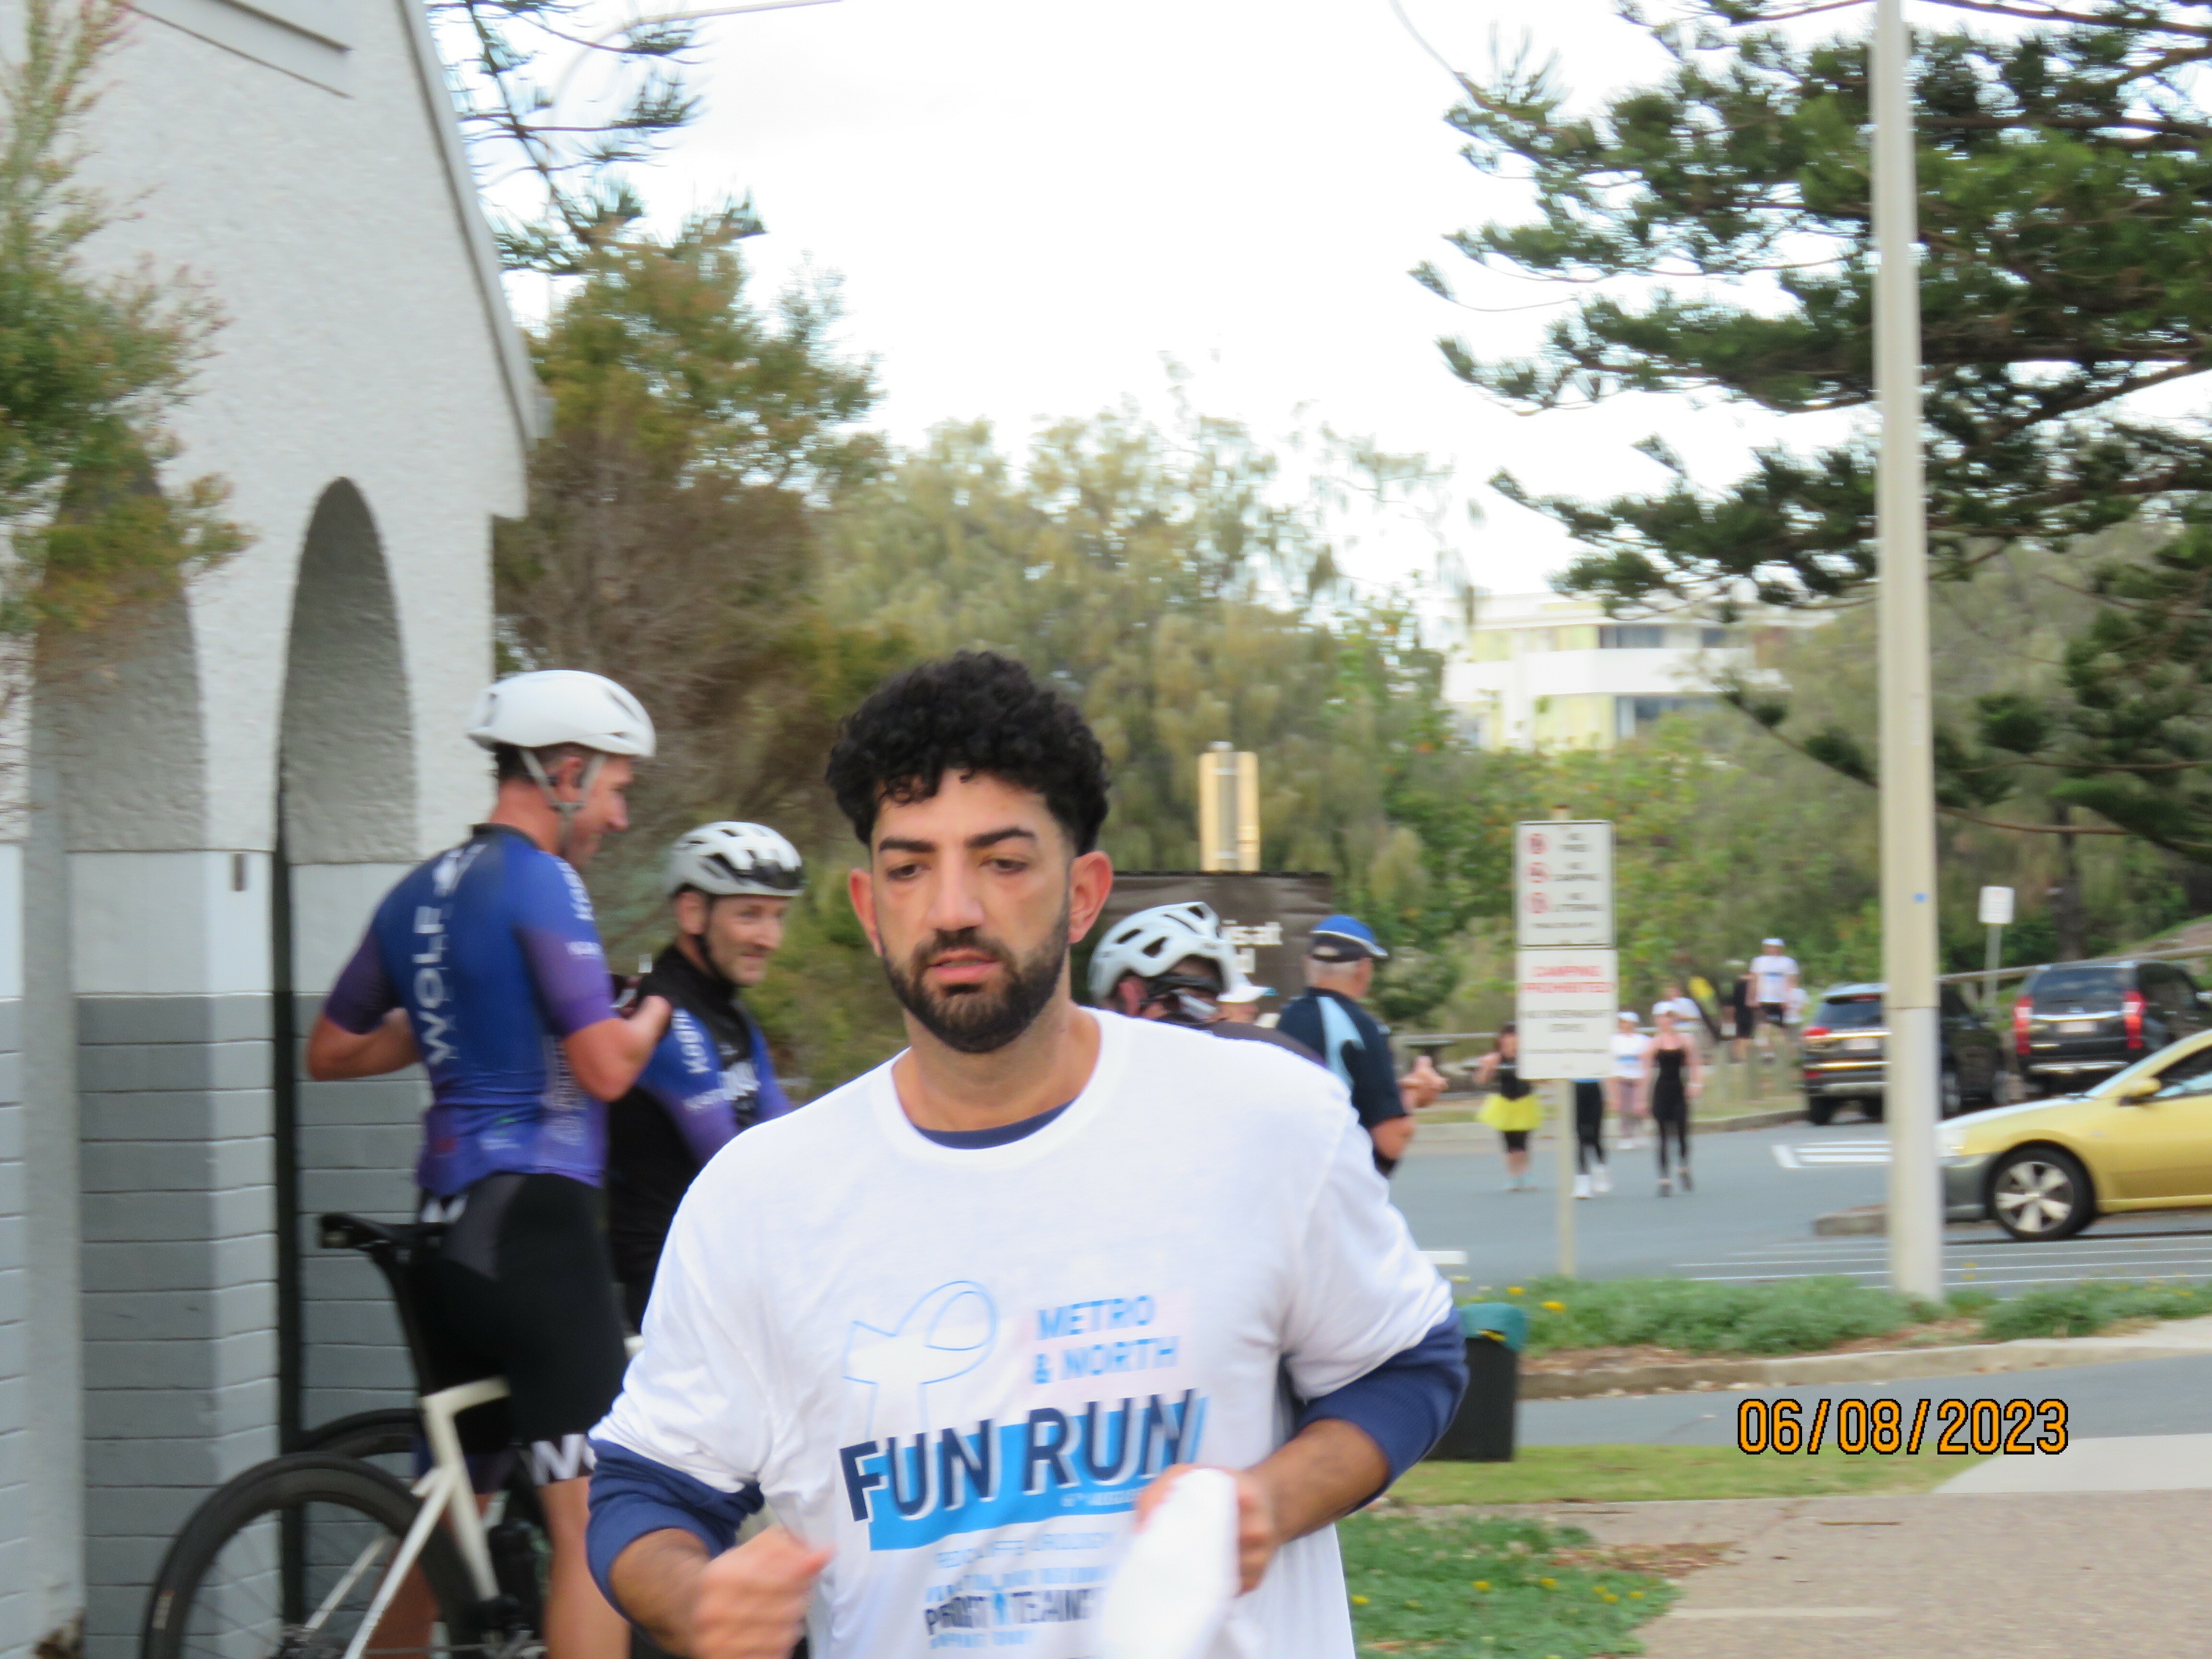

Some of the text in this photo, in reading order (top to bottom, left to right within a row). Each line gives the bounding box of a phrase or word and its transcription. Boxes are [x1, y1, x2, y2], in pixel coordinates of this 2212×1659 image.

[1037, 1294, 1154, 1340] METRO
[1033, 1335, 1180, 1384] & NORTH
[840, 1388, 1200, 1522] FUN RUN
